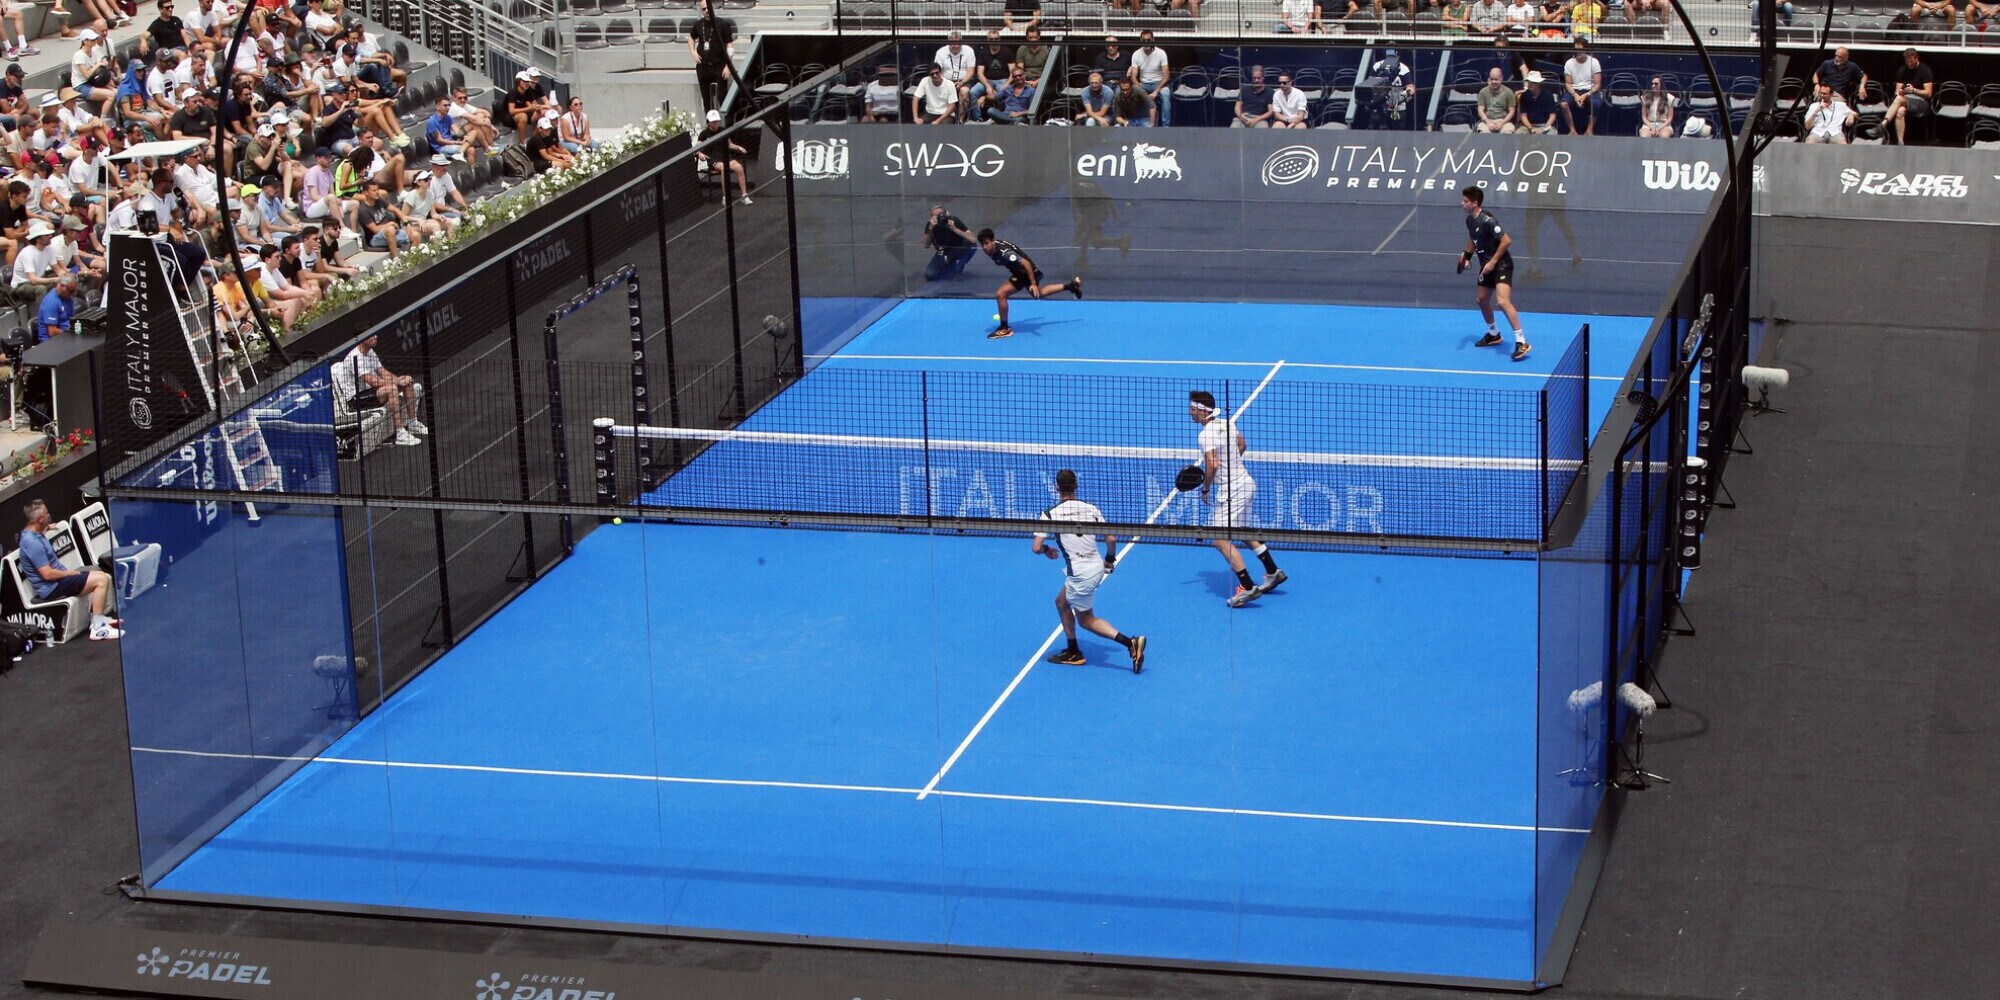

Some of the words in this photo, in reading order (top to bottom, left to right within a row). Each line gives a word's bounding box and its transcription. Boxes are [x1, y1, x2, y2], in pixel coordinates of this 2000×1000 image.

[883, 142, 1005, 178] SWAG
[1077, 145, 1128, 177] eni
[1329, 145, 1435, 174] ITALY
[1440, 148, 1572, 178] MAJOR
[1641, 160, 1722, 191] Wils
[1326, 176, 1457, 191] PREMIER
[1475, 180, 1567, 194] PADEL
[1857, 182, 1969, 198] NUESTRO
[1861, 172, 1965, 189] PADEL
[634, 182, 670, 217] PADL
[122, 258, 140, 331] MAJOR
[139, 260, 148, 312] PADEL
[125, 333, 143, 392] ITALY
[142, 321, 151, 394] PREMIER
[1146, 474, 1384, 533] MJOR
[179, 948, 241, 960] PREMIER
[168, 960, 272, 985] PADEL
[521, 974, 586, 985] PREMIER
